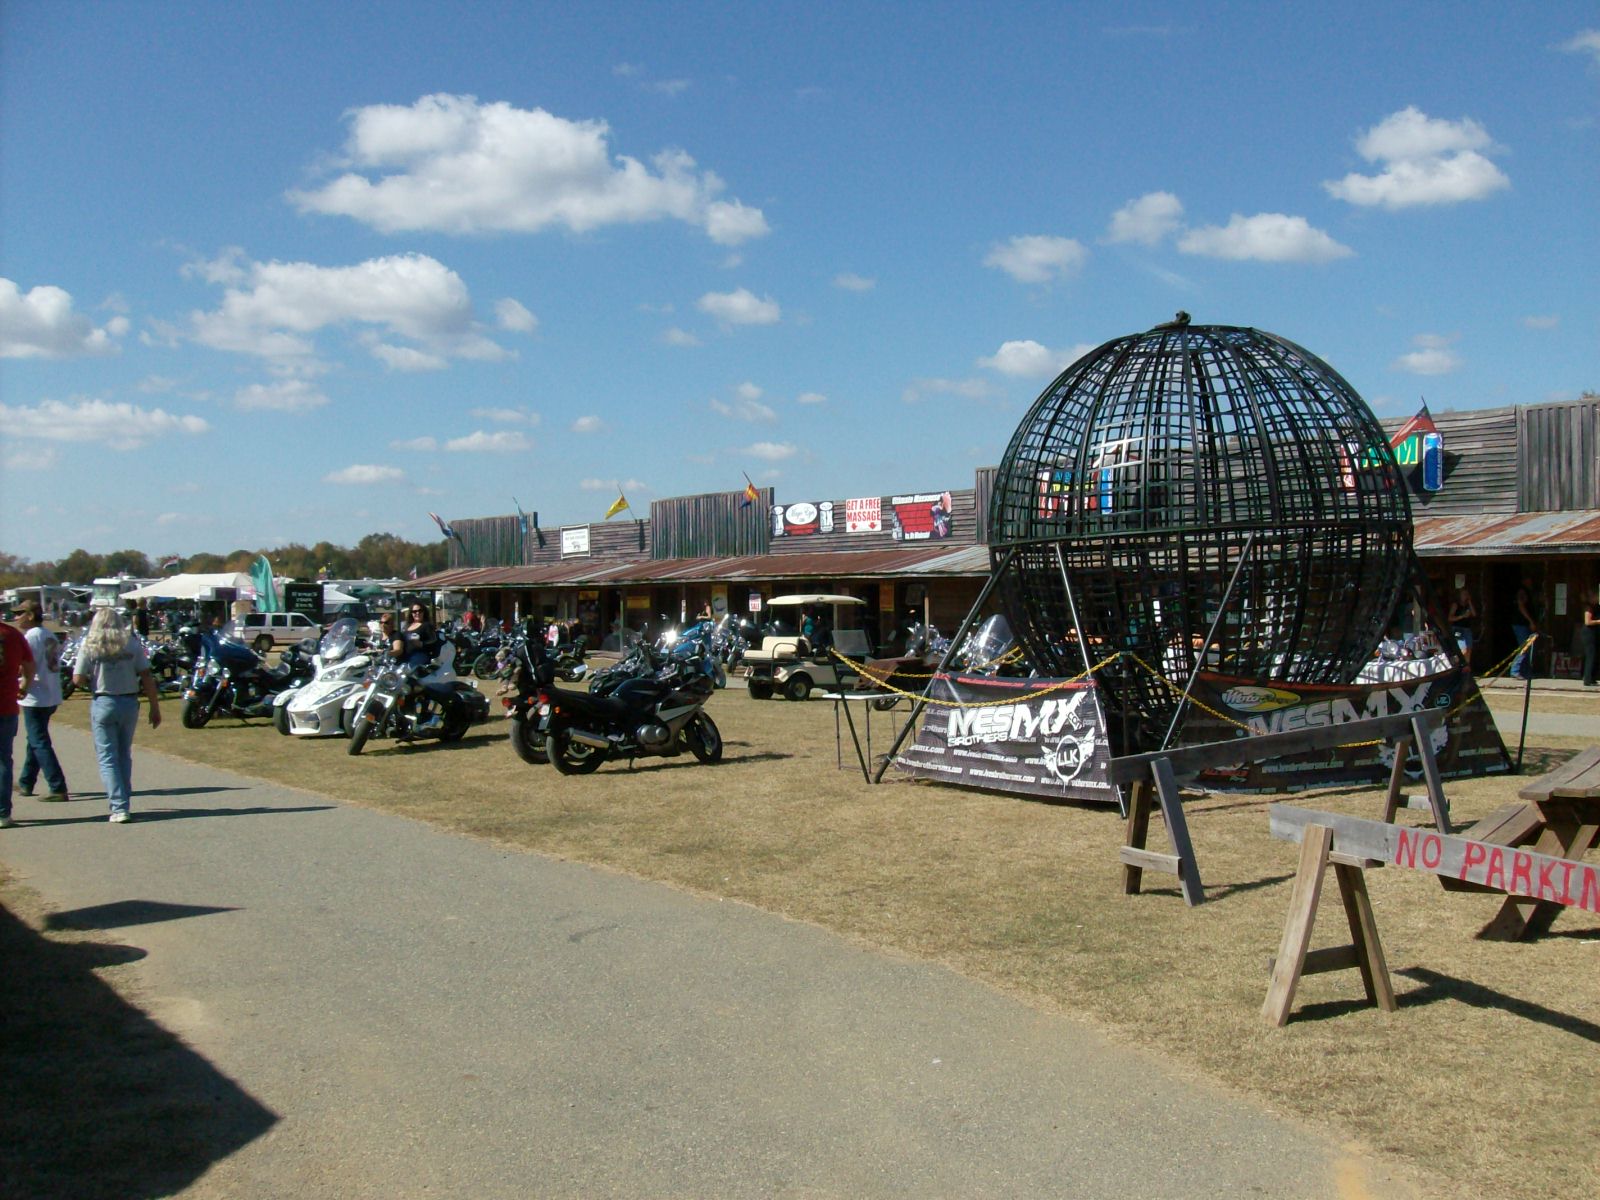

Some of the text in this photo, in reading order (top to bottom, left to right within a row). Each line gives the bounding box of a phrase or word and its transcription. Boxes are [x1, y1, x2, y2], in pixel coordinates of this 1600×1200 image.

[846, 500, 858, 510] GET
[859, 499, 864, 510] A
[865, 498, 880, 509] FREE
[846, 510, 880, 522] MASSAGE
[947, 731, 1009, 747] BROTHERS
[1058, 749, 1079, 766] LLK
[1395, 829, 1600, 913] NO PARKIN
